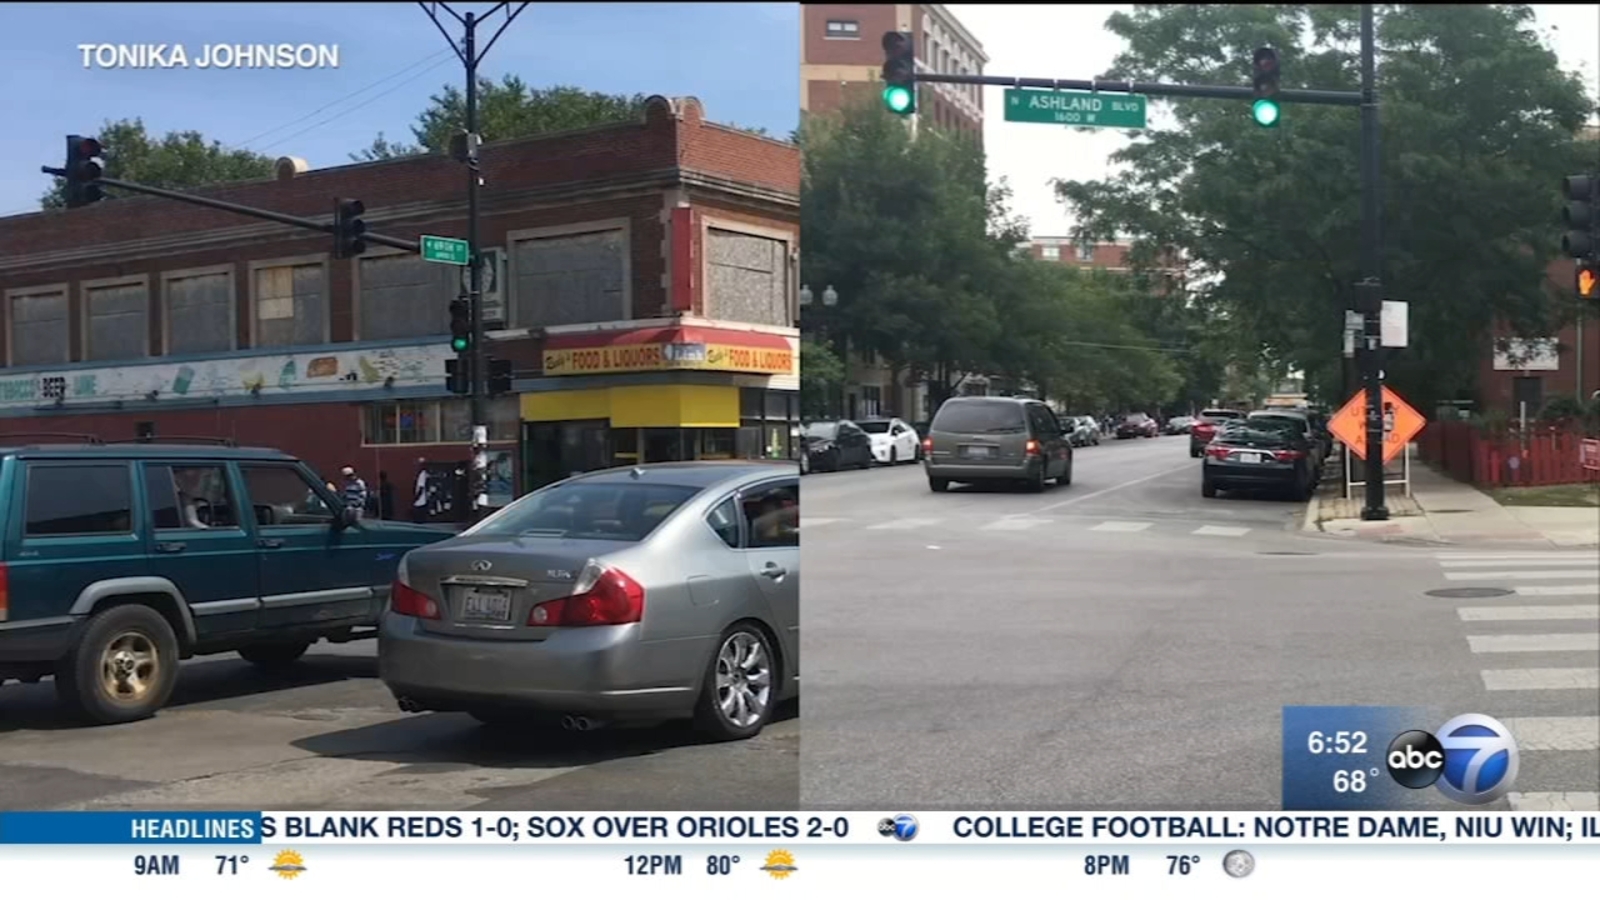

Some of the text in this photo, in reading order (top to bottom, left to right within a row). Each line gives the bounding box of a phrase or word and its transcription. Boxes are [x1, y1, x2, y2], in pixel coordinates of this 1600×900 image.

[1010, 94, 1139, 112] N ASHLAND BLVD
[1054, 111, 1097, 123] 1600 W
[572, 350, 600, 370] FOOD
[603, 349, 611, 368] &
[614, 346, 661, 368] LIQUORS
[729, 348, 750, 368] FOOD
[752, 349, 759, 368] &
[760, 350, 792, 371] LIQUORS
